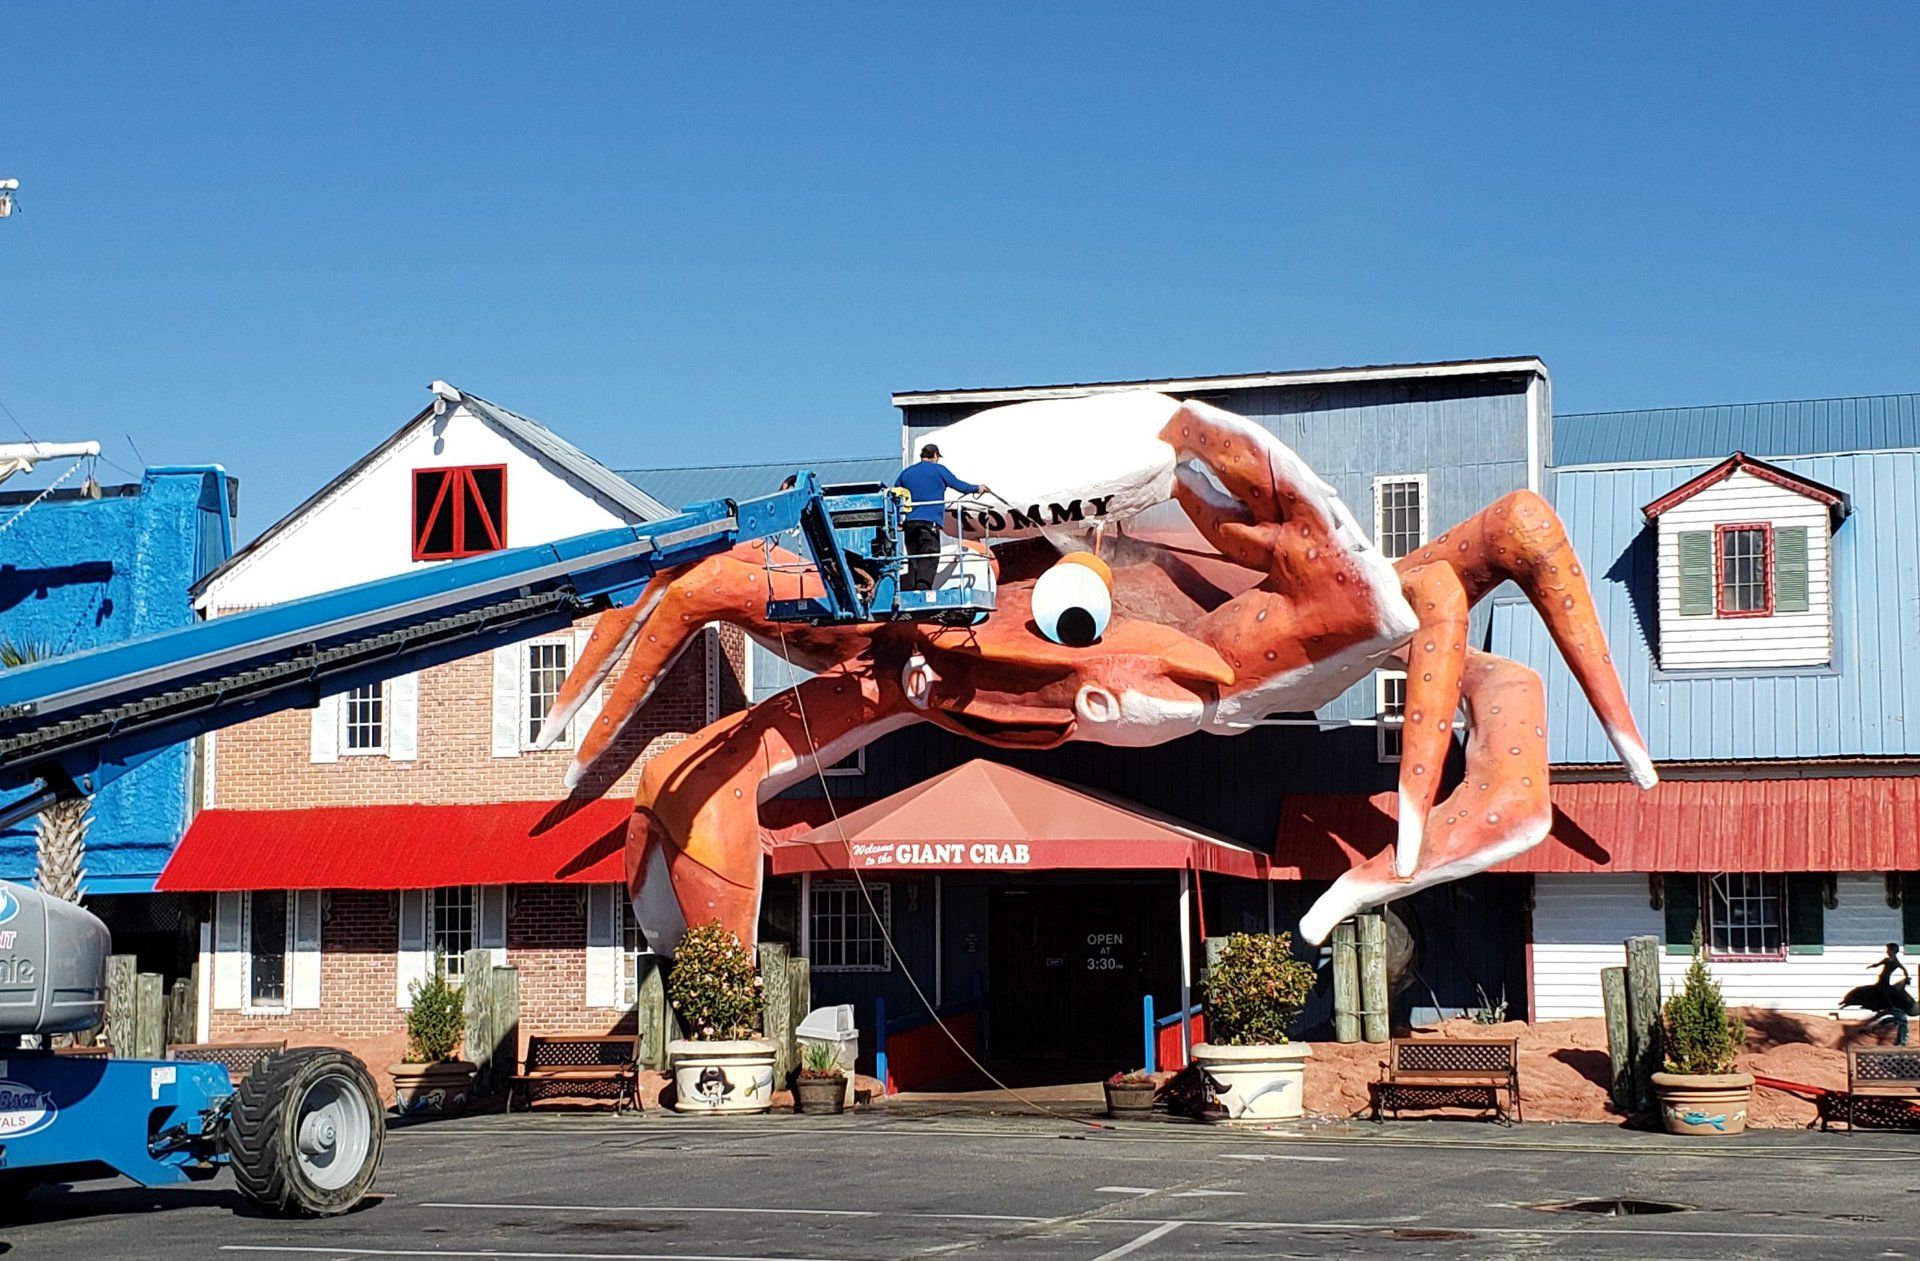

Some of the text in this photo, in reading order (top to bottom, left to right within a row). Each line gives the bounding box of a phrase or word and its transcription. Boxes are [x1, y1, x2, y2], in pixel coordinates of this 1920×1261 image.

[946, 495, 1115, 532] TOMMY
[853, 843, 894, 855] Welcome
[895, 843, 1030, 864] GIANT CRAB
[866, 852, 893, 866] to the
[1087, 934, 1123, 945] OPEN
[1100, 947, 1111, 955] AT
[1087, 957, 1116, 970] 3:30
[0, 1116, 26, 1127] ALS
